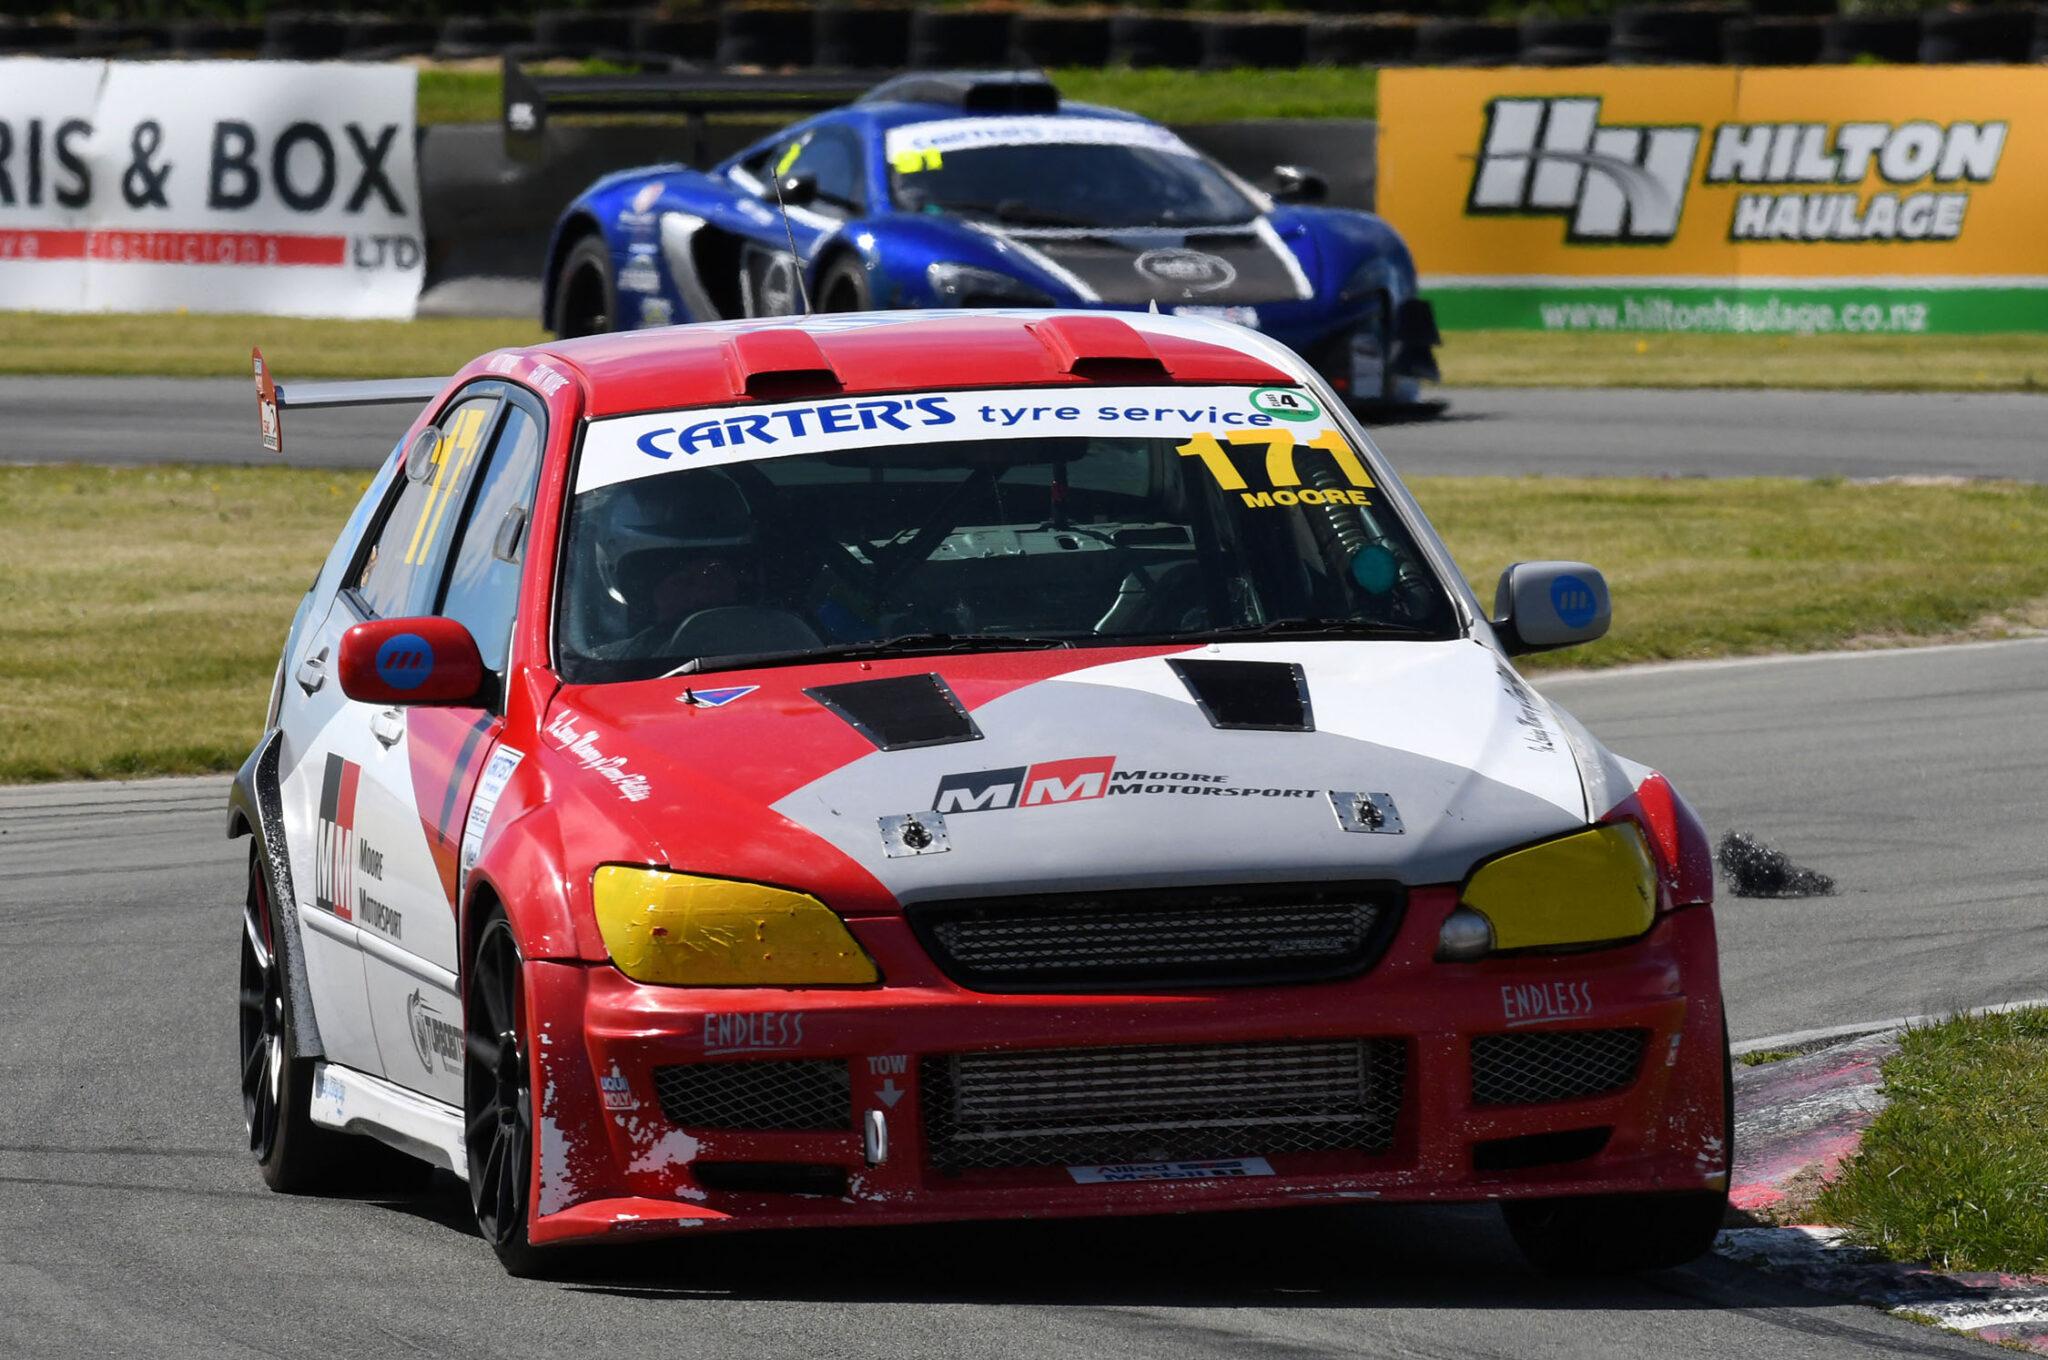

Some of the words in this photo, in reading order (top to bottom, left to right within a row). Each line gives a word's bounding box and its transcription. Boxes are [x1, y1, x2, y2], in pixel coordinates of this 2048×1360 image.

[122, 119, 173, 209] &
[208, 119, 407, 216] BOX
[1704, 121, 2008, 184] HILTON
[1728, 193, 1969, 241] HAULAGE
[352, 233, 422, 270] LTD
[1540, 299, 1929, 332] www.hiltonhaulage.co.nz
[1281, 394, 1299, 408] 4
[636, 396, 957, 460] CARTER'S
[978, 403, 1080, 426] tyre
[1098, 403, 1273, 427] service
[1175, 427, 1376, 491] 171
[1241, 488, 1372, 509] MOORE
[1501, 981, 1594, 1018] ENDLESS
[703, 1012, 804, 1047] ENDLESS
[867, 1055, 909, 1075] TOW
